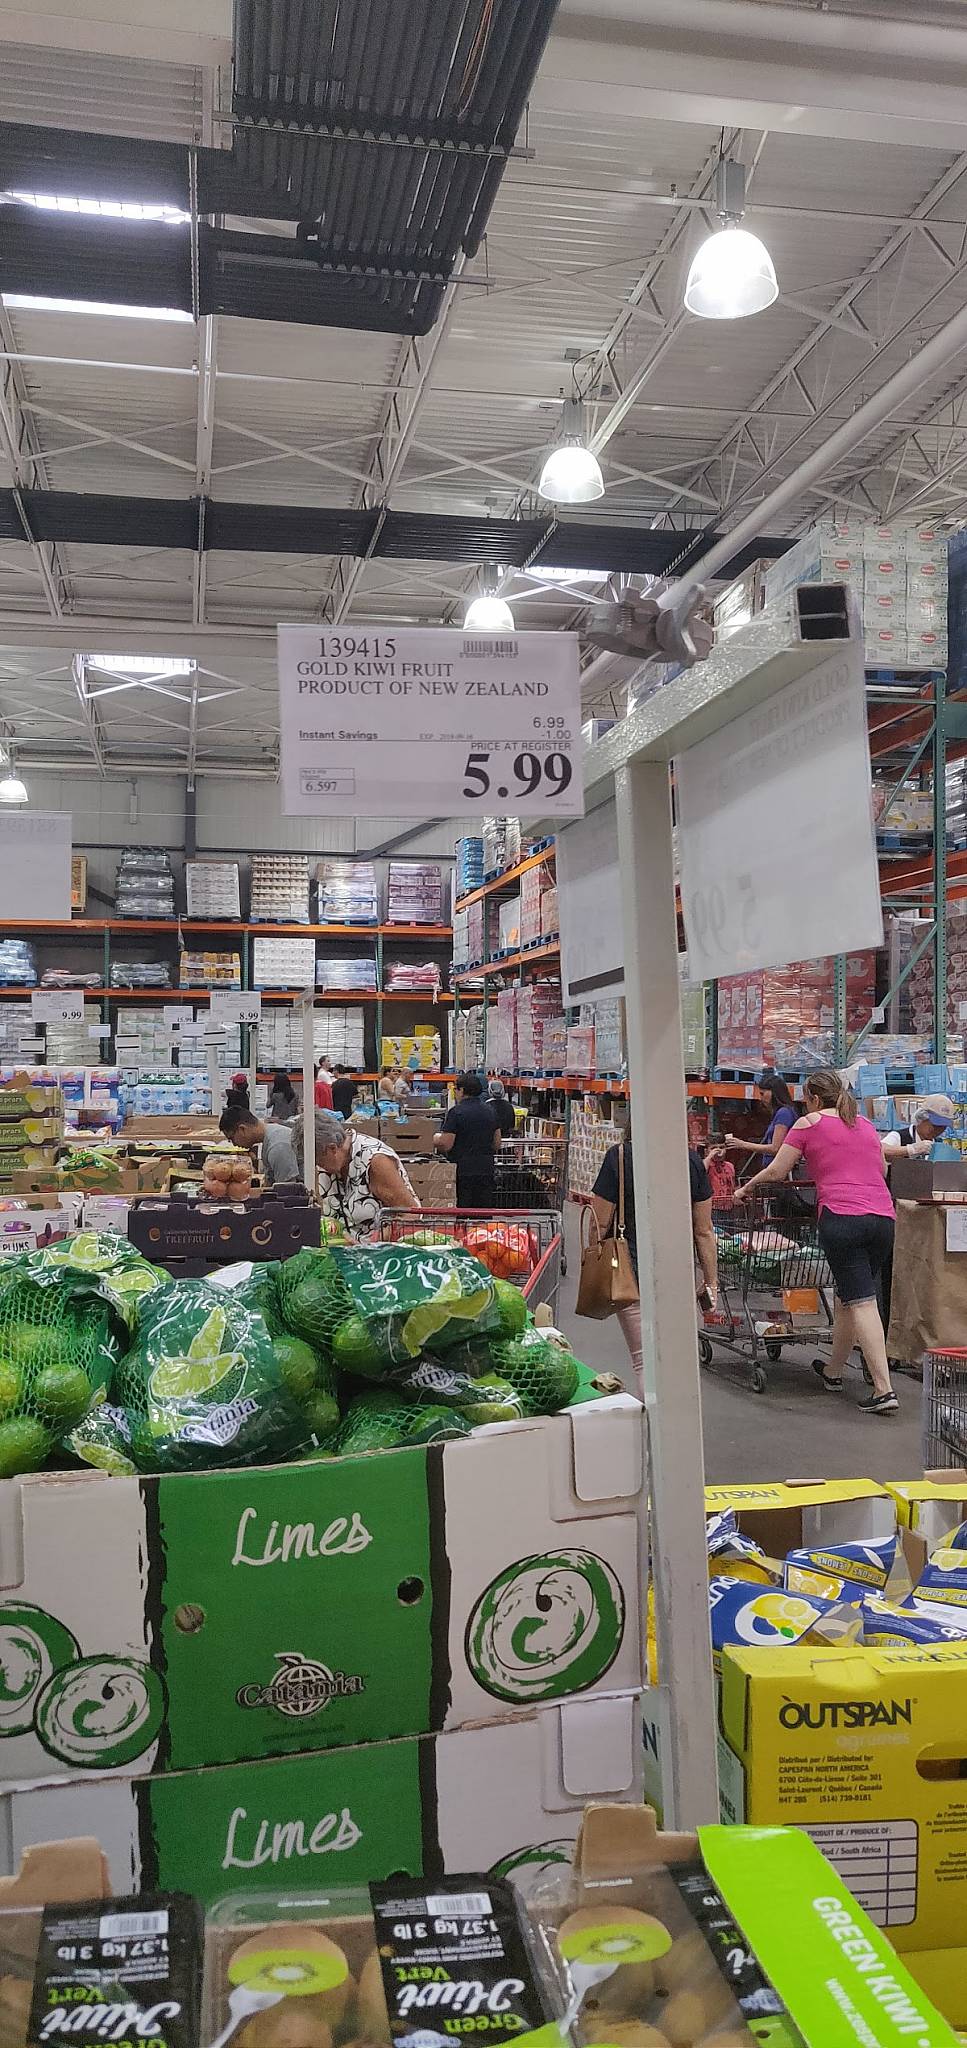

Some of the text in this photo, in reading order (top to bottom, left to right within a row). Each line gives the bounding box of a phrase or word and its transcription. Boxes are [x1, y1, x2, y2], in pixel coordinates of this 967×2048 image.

[318, 638, 397, 658] 139415
[297, 662, 454, 677] GOLD KIWI FRUIT
[298, 680, 549, 697] PRODUCT OF NEW ZEALAND
[533, 717, 565, 728] 6.99
[299, 730, 378, 741] Instant Savings
[540, 730, 571, 740] -1.00
[471, 743, 572, 751] PRICE AT REGISTER
[463, 752, 572, 798] 5.99
[305, 781, 337, 792] 6.597
[62, 1011, 82, 1020] 9.99
[239, 1012, 258, 1021] 8.99
[4, 1096, 22, 1104] pears
[2, 1128, 21, 1136] pears
[2, 1157, 20, 1165] pears
[705, 1489, 780, 1501] UTSPAN
[231, 1508, 374, 1566] Limes
[236, 1672, 366, 1709] Catania
[779, 1697, 912, 1729] OUTSPAN
[815, 1765, 838, 1773] NORTH
[839, 1764, 870, 1772] AMERICA
[870, 1773, 882, 1781] 301
[858, 1784, 883, 1792] Canada
[222, 1807, 364, 1869] Limes
[807, 1829, 834, 1837] PRODUIT
[841, 1846, 860, 1854] South
[861, 1846, 882, 1854] Africa
[393, 1918, 499, 1940] 1.37 kg 3 lb
[57, 1939, 170, 1961] 1.37 kg 3 lb
[812, 1896, 930, 2034] GREEN KIWI
[394, 1966, 451, 1982] Vert
[47, 1986, 106, 2005] Vert
[395, 1978, 525, 2017] Kiwi
[38, 2001, 181, 2040] Kiwi
[443, 2013, 523, 2034] Green
